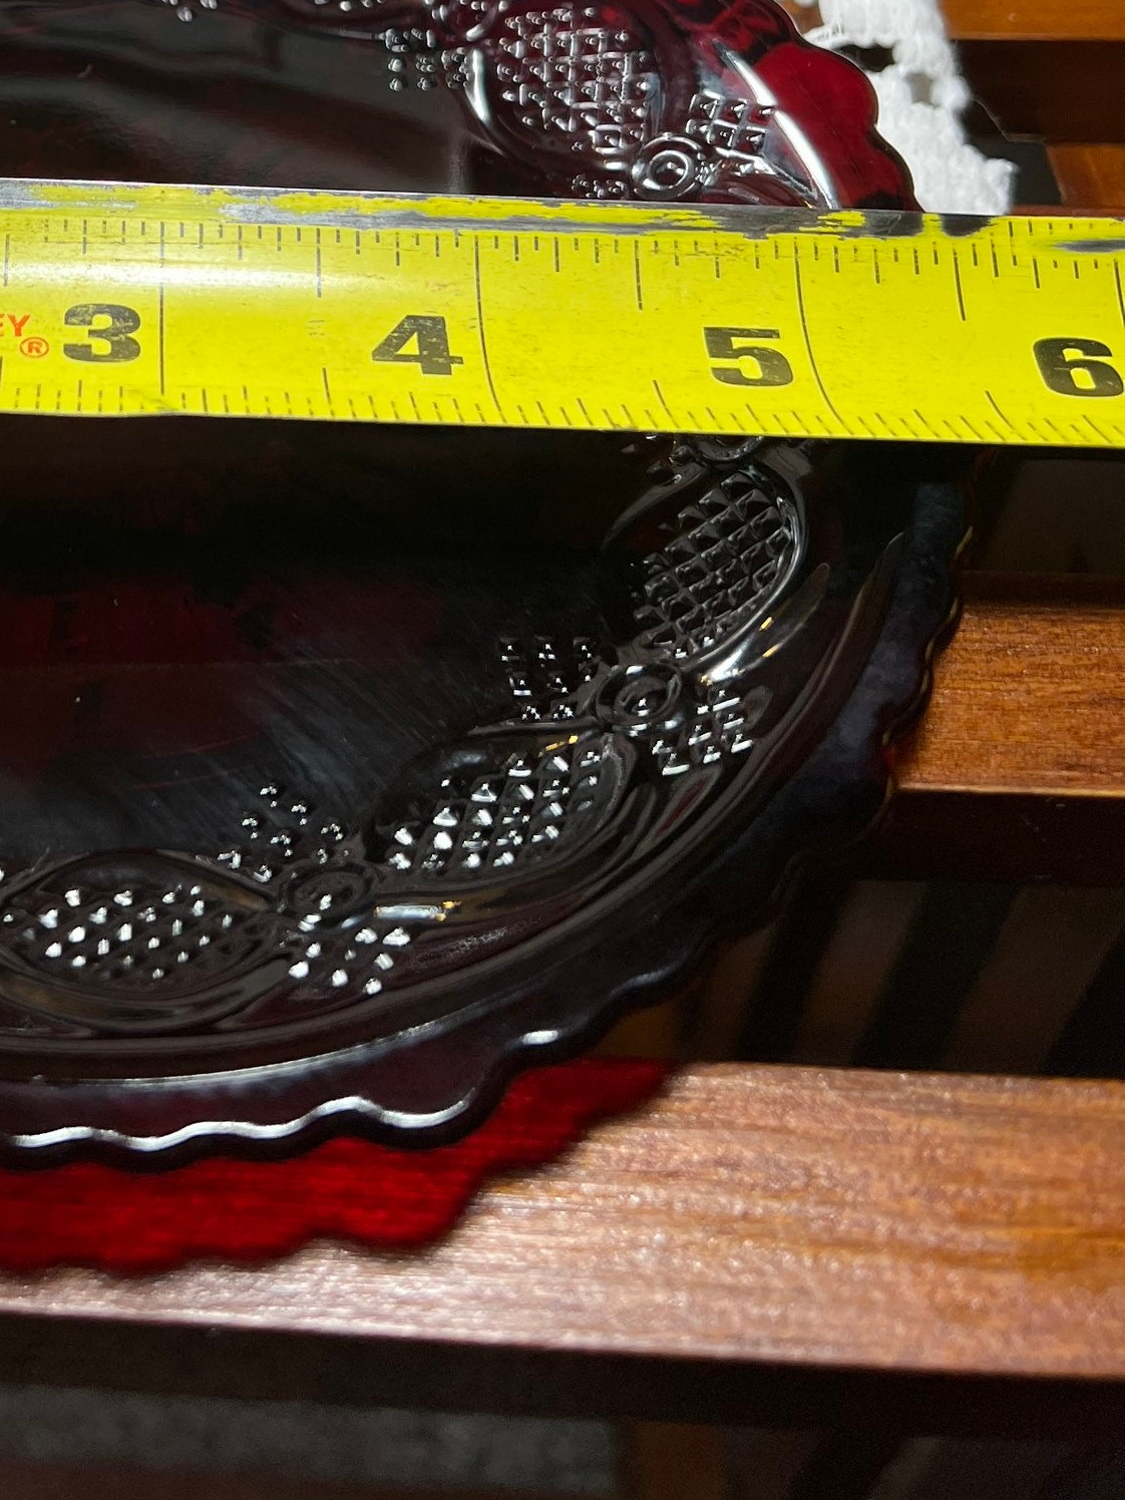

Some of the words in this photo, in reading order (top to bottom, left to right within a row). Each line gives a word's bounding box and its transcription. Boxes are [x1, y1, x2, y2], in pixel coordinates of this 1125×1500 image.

[62, 302, 141, 363] 3
[371, 314, 463, 375] 4
[703, 326, 793, 387] 5
[1032, 337, 1124, 397] 6
